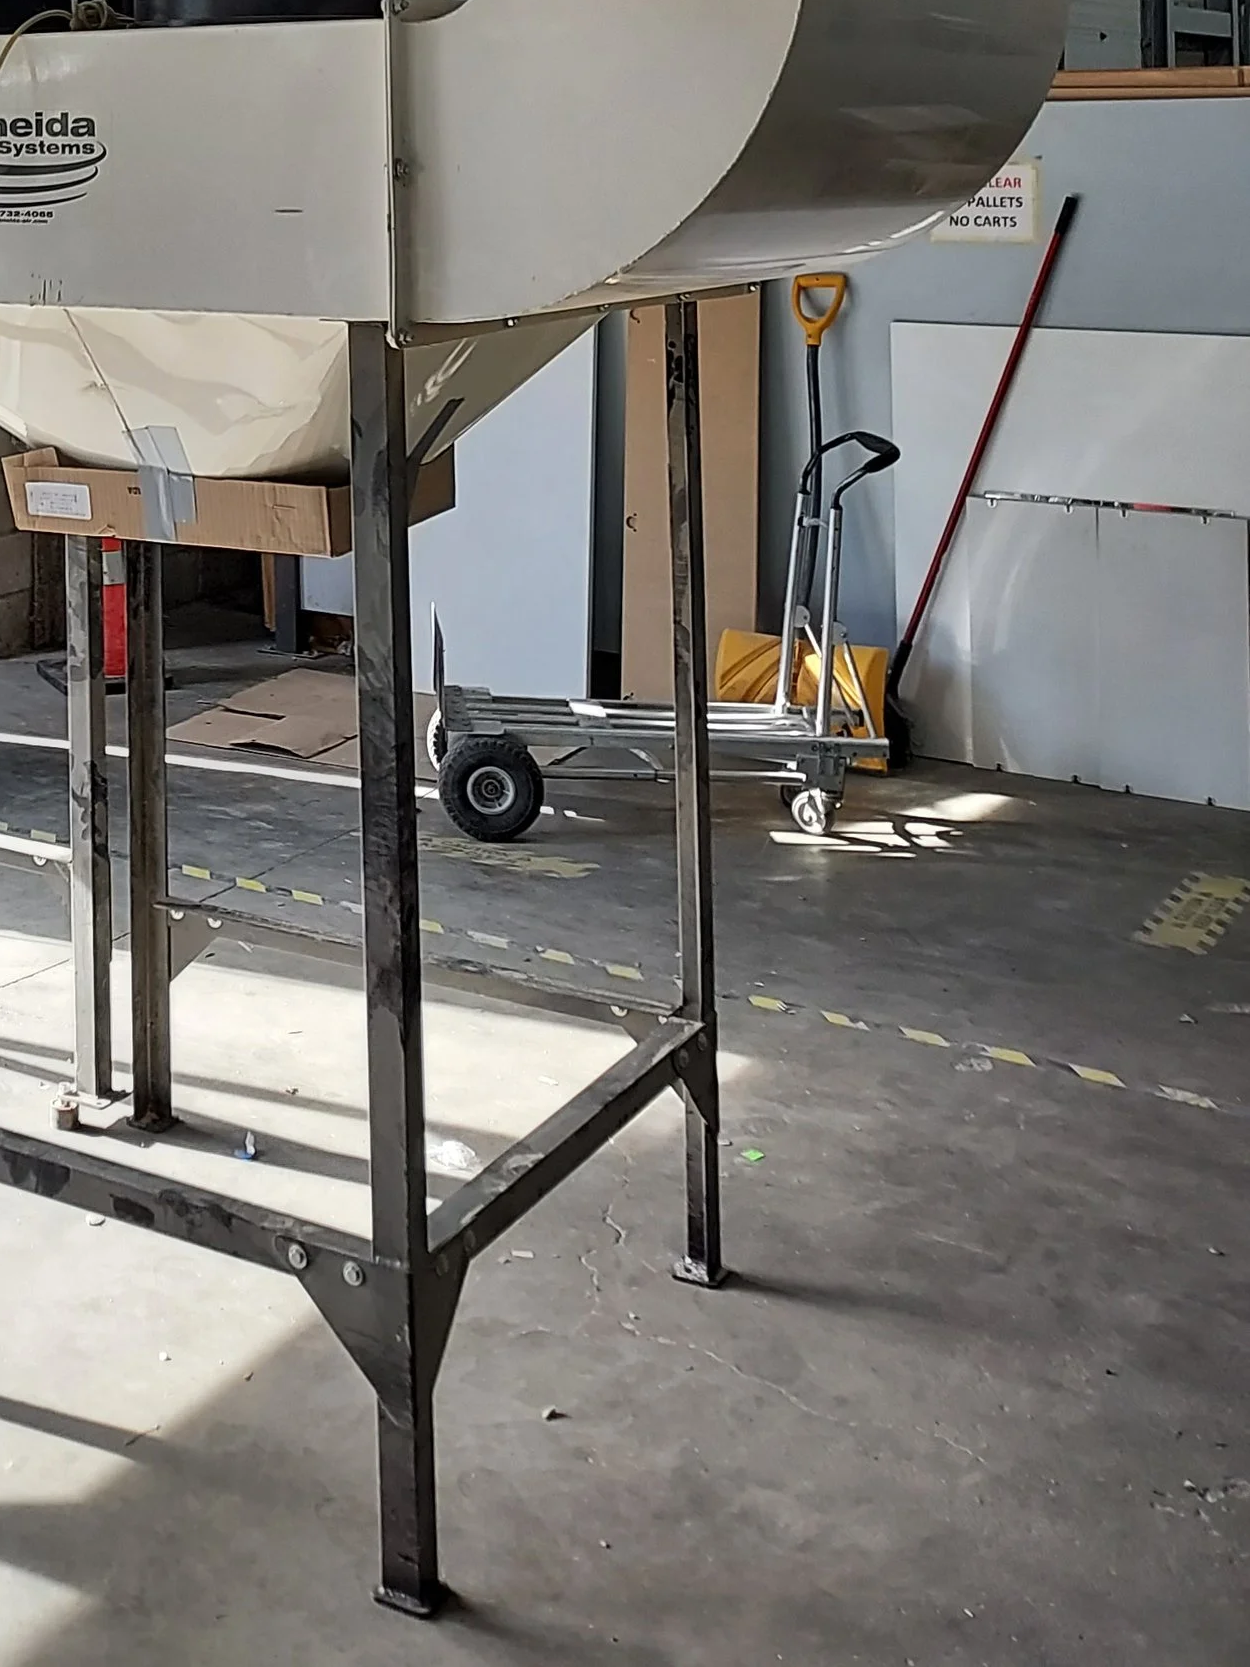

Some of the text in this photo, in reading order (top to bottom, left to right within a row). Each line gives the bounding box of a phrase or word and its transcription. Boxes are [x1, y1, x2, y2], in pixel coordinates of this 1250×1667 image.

[988, 177, 1021, 188] LEAR
[967, 196, 1023, 208] PALLETS
[950, 215, 1017, 228] NO CARTS
